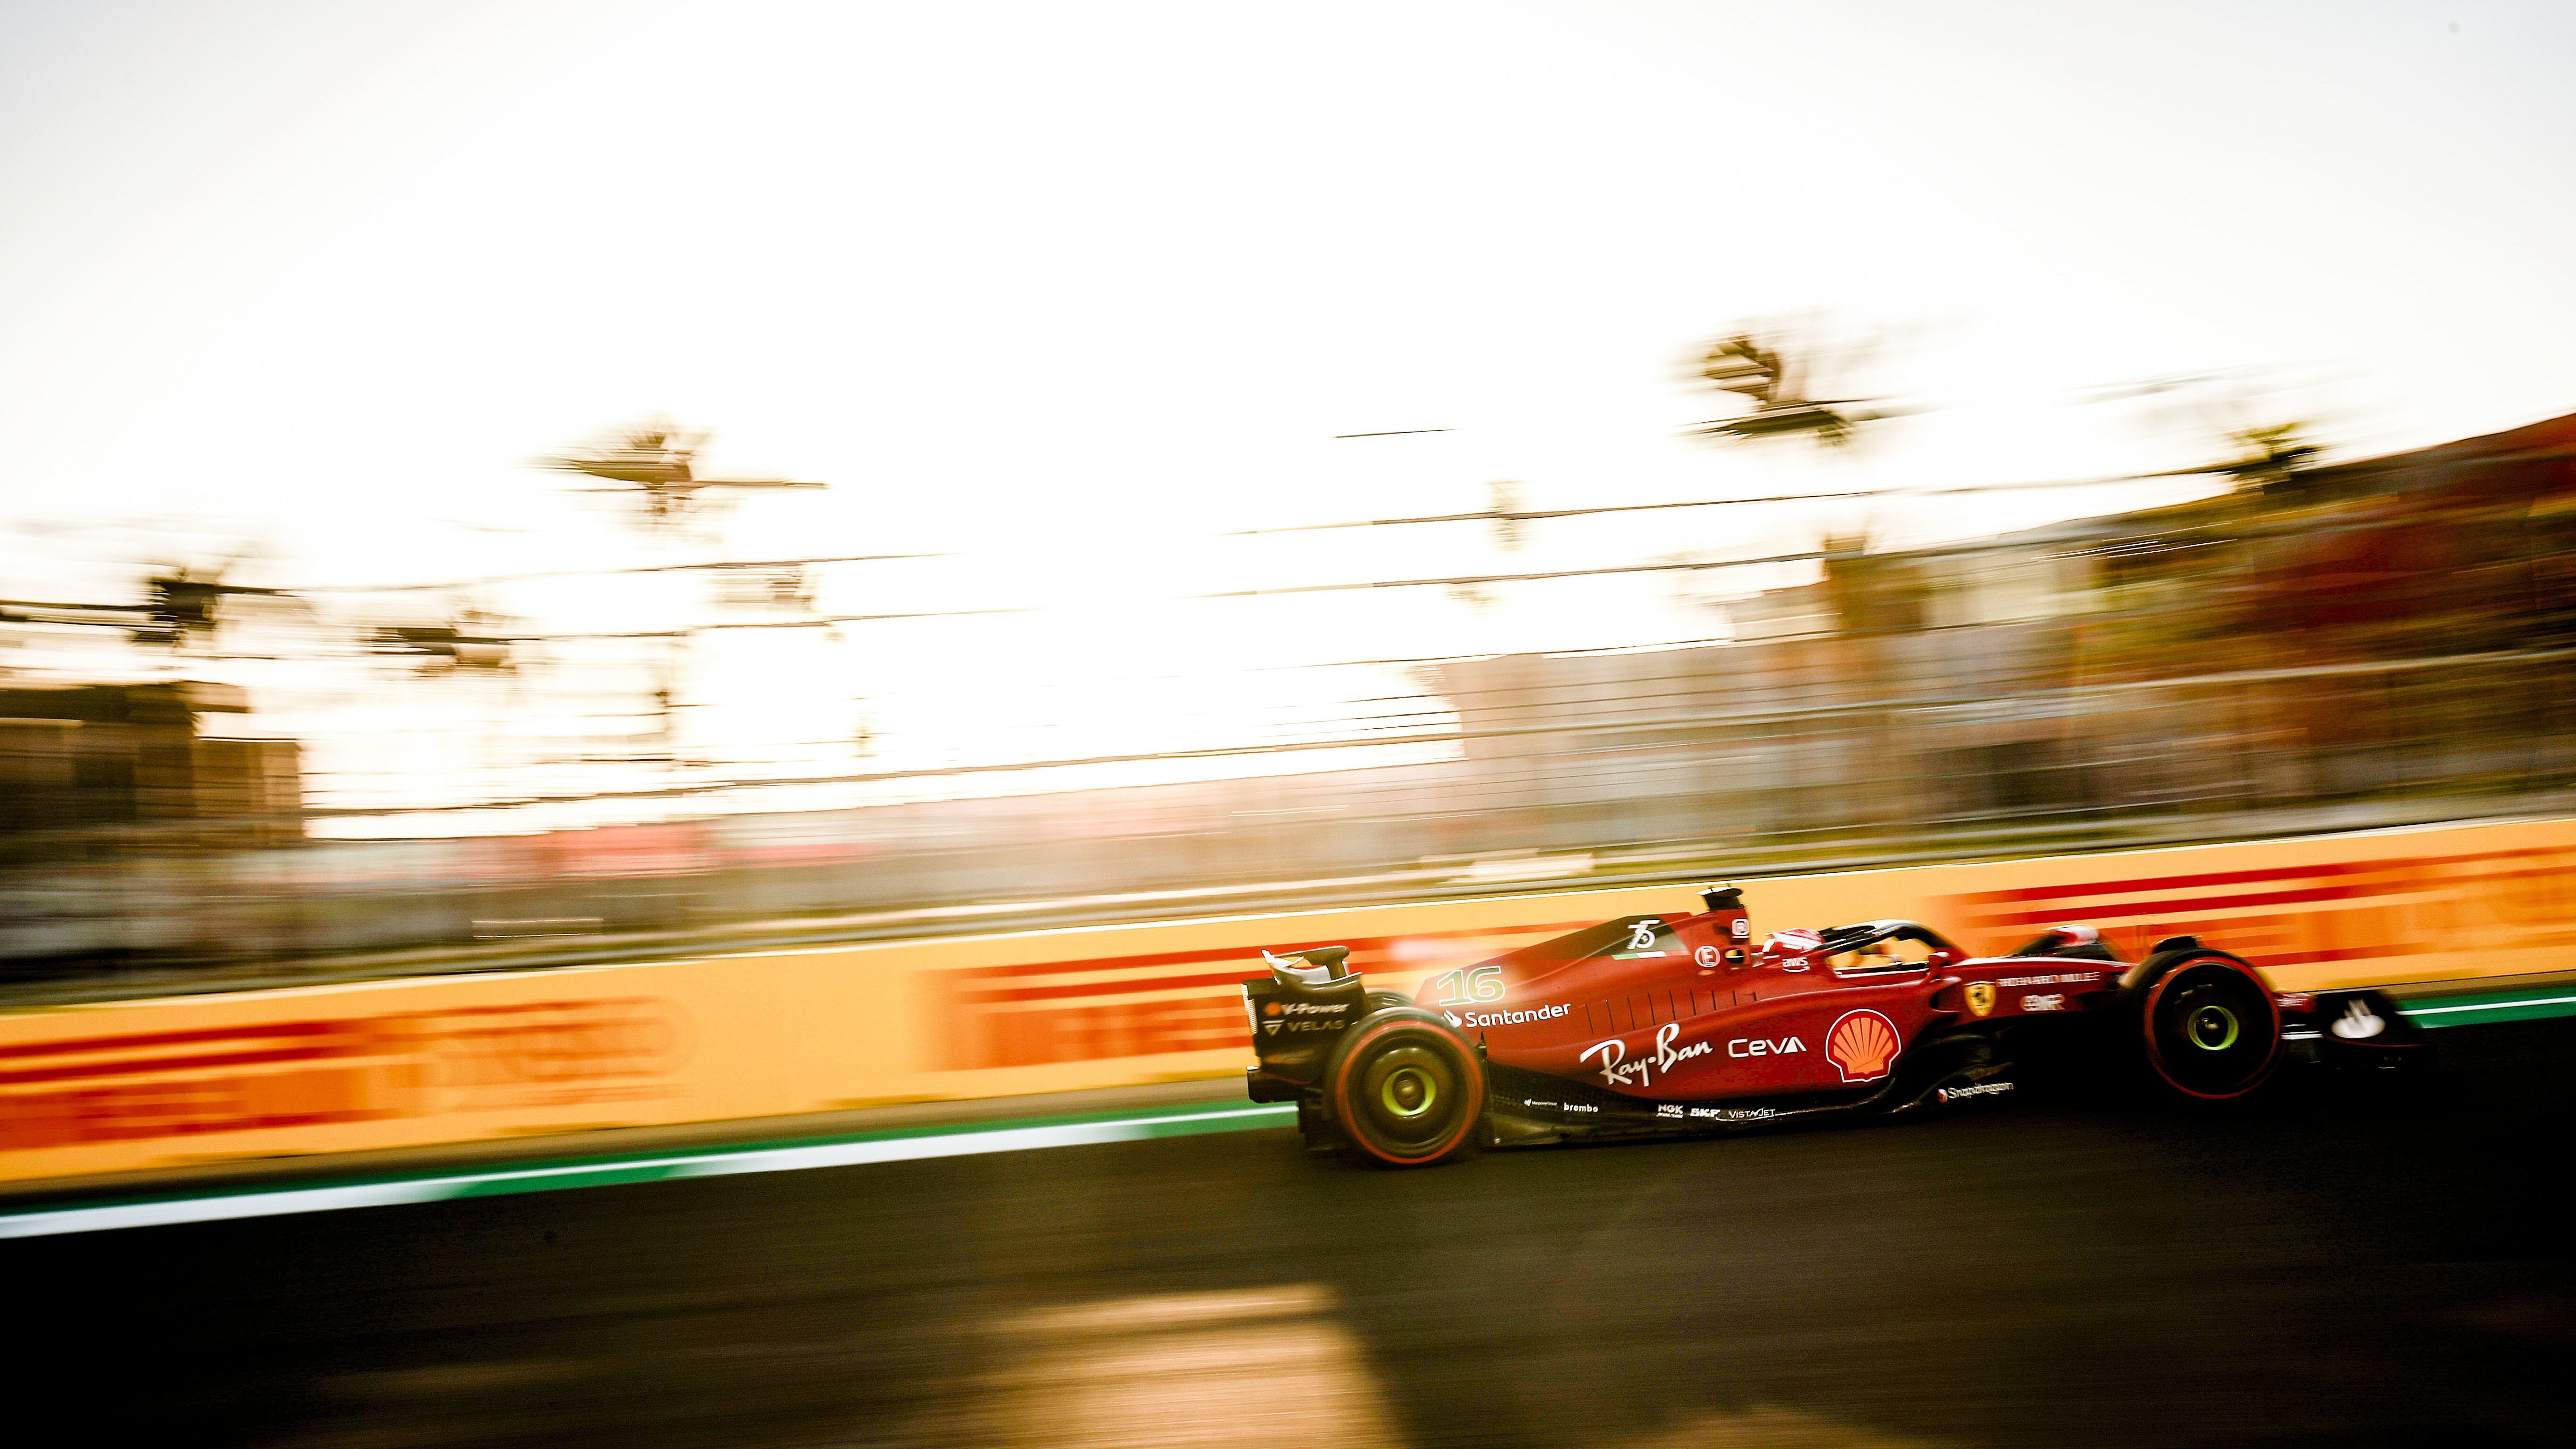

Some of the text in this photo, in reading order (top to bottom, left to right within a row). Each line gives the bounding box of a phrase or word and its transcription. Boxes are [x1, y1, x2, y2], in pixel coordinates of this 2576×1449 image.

[1782, 957, 1808, 967] aws
[1437, 966, 1505, 1007] 16
[1465, 1003, 1571, 1027] Santander
[1287, 1020, 1345, 1032] VELAS
[1948, 1082, 2014, 1098] Snapdragon
[1563, 1102, 1599, 1112] brembo
[1658, 1104, 1683, 1114] NGK
[1690, 1108, 1721, 1117] SKF
